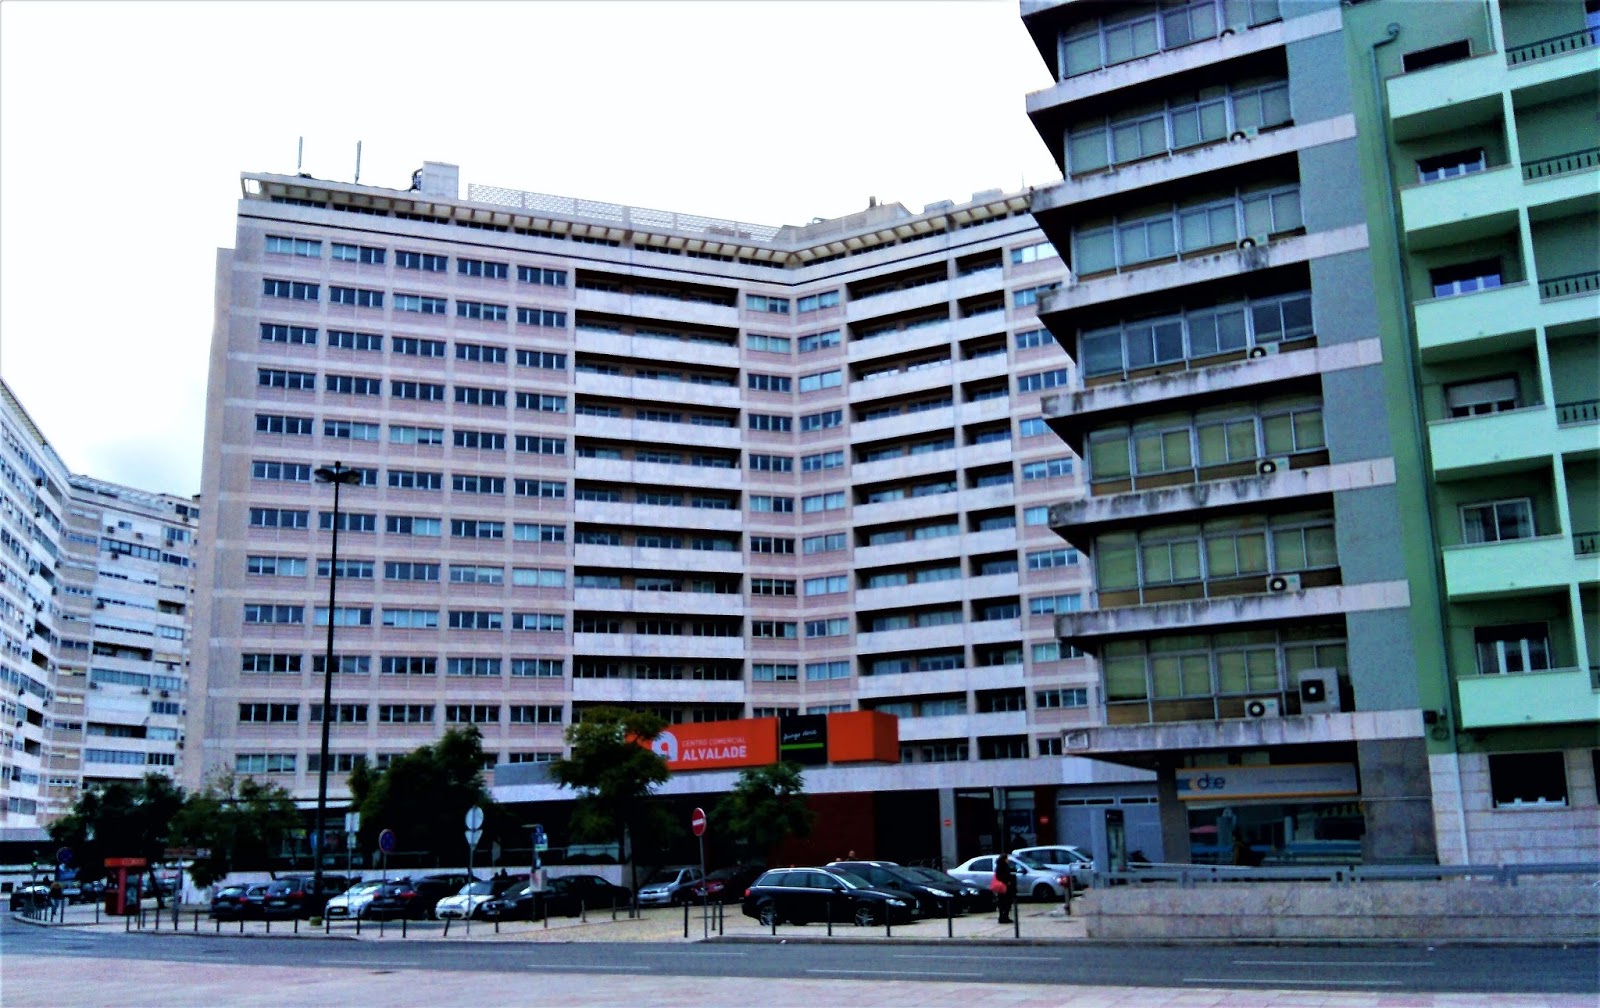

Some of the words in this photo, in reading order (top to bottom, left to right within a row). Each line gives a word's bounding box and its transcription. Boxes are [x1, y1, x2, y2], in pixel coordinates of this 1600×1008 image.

[682, 739, 708, 747] CENTRO
[709, 737, 745, 745] COMERCIAL
[682, 745, 747, 761] ALVALADE
